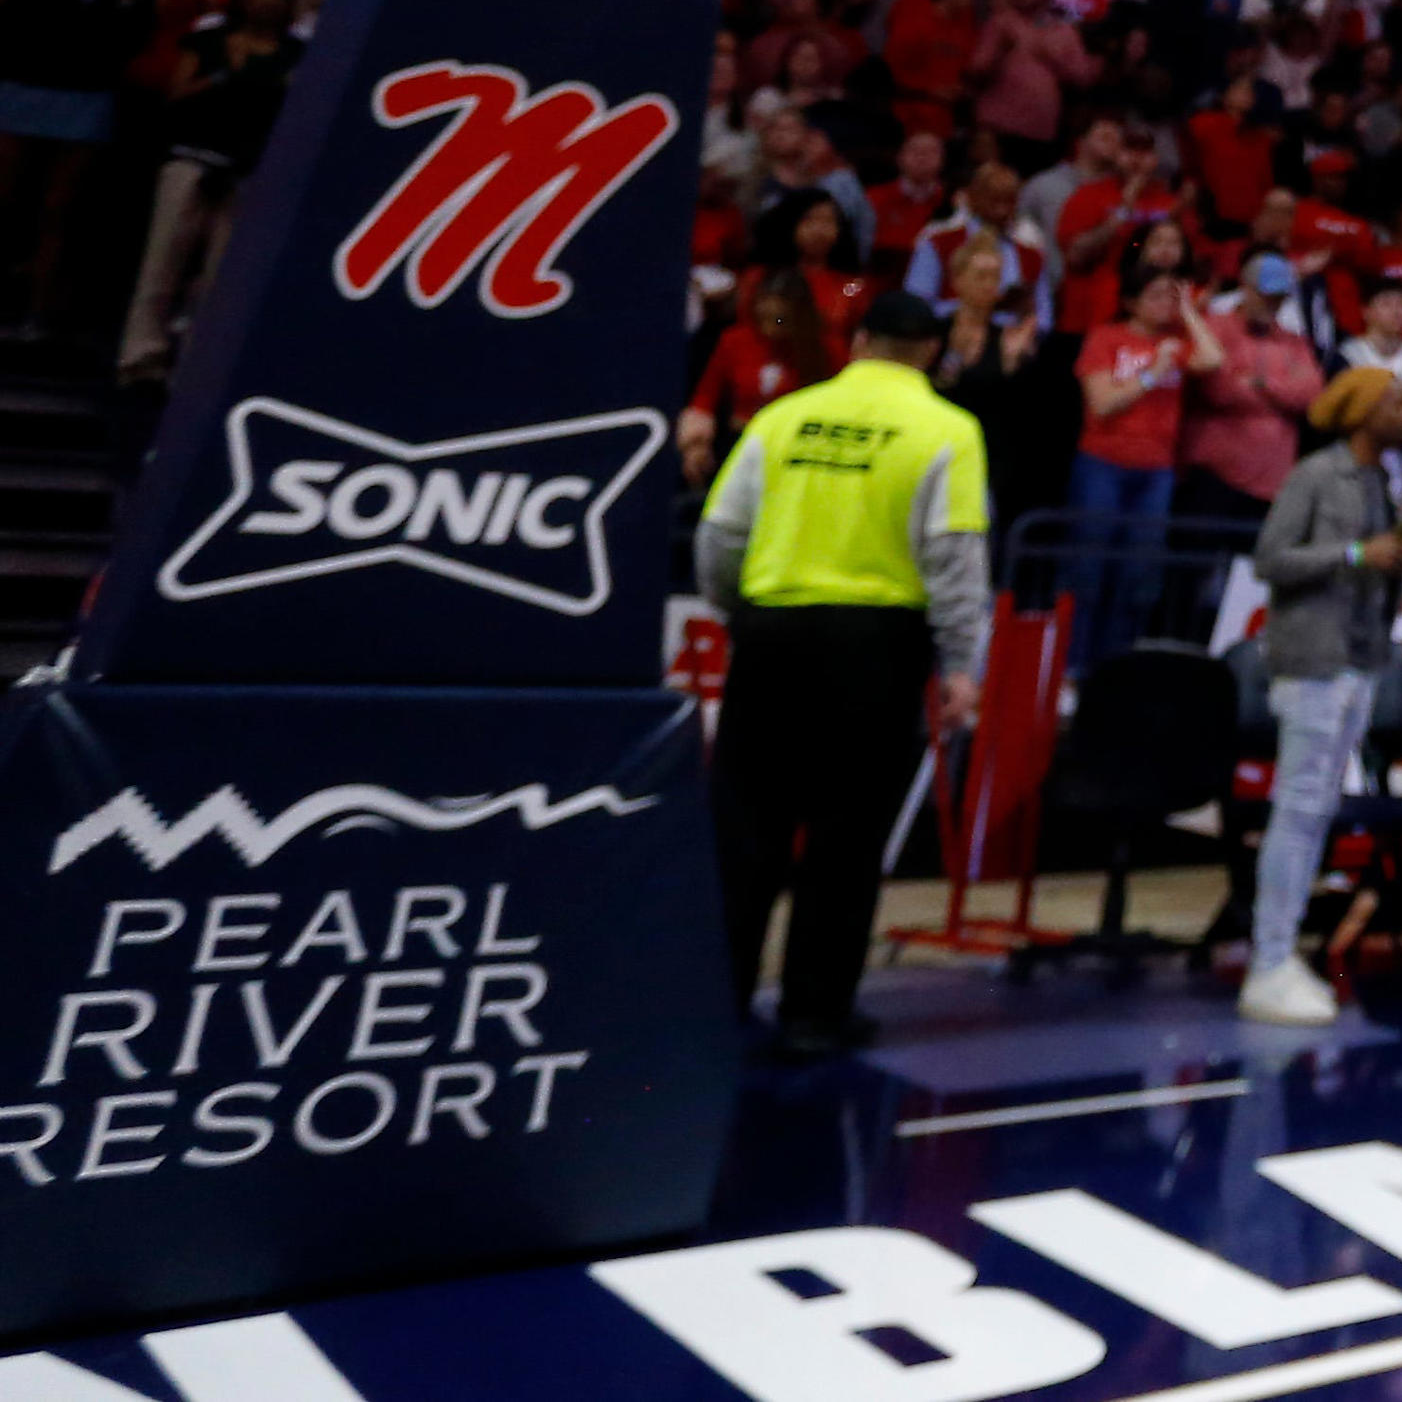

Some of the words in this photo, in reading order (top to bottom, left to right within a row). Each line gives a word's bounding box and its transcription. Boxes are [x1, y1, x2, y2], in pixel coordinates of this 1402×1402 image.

[239, 460, 594, 550] SONIC
[87, 882, 542, 979] PEARL
[35, 961, 549, 1088] RIVER
[0, 1049, 590, 1187] RESORT
